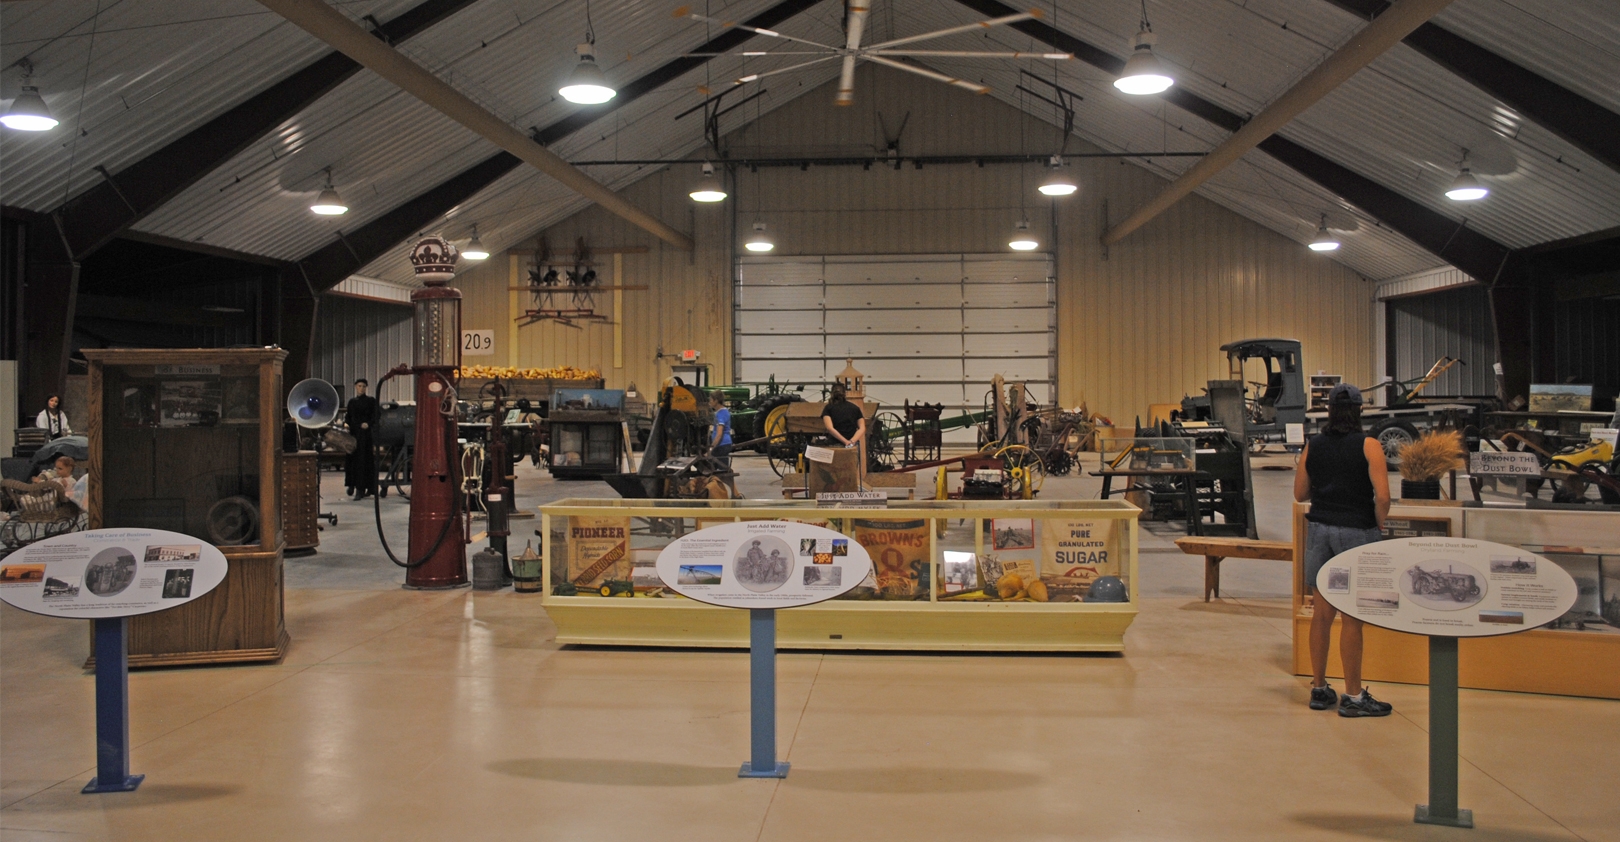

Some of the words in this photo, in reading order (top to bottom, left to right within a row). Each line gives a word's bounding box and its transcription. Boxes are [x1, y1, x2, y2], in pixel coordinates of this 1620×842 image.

[465, 333, 491, 350] 20.9
[1509, 465, 1534, 473] BOWL
[572, 527, 625, 539] PIONEER
[1071, 530, 1091, 538] PURE
[1055, 550, 1108, 564] SUGAR
